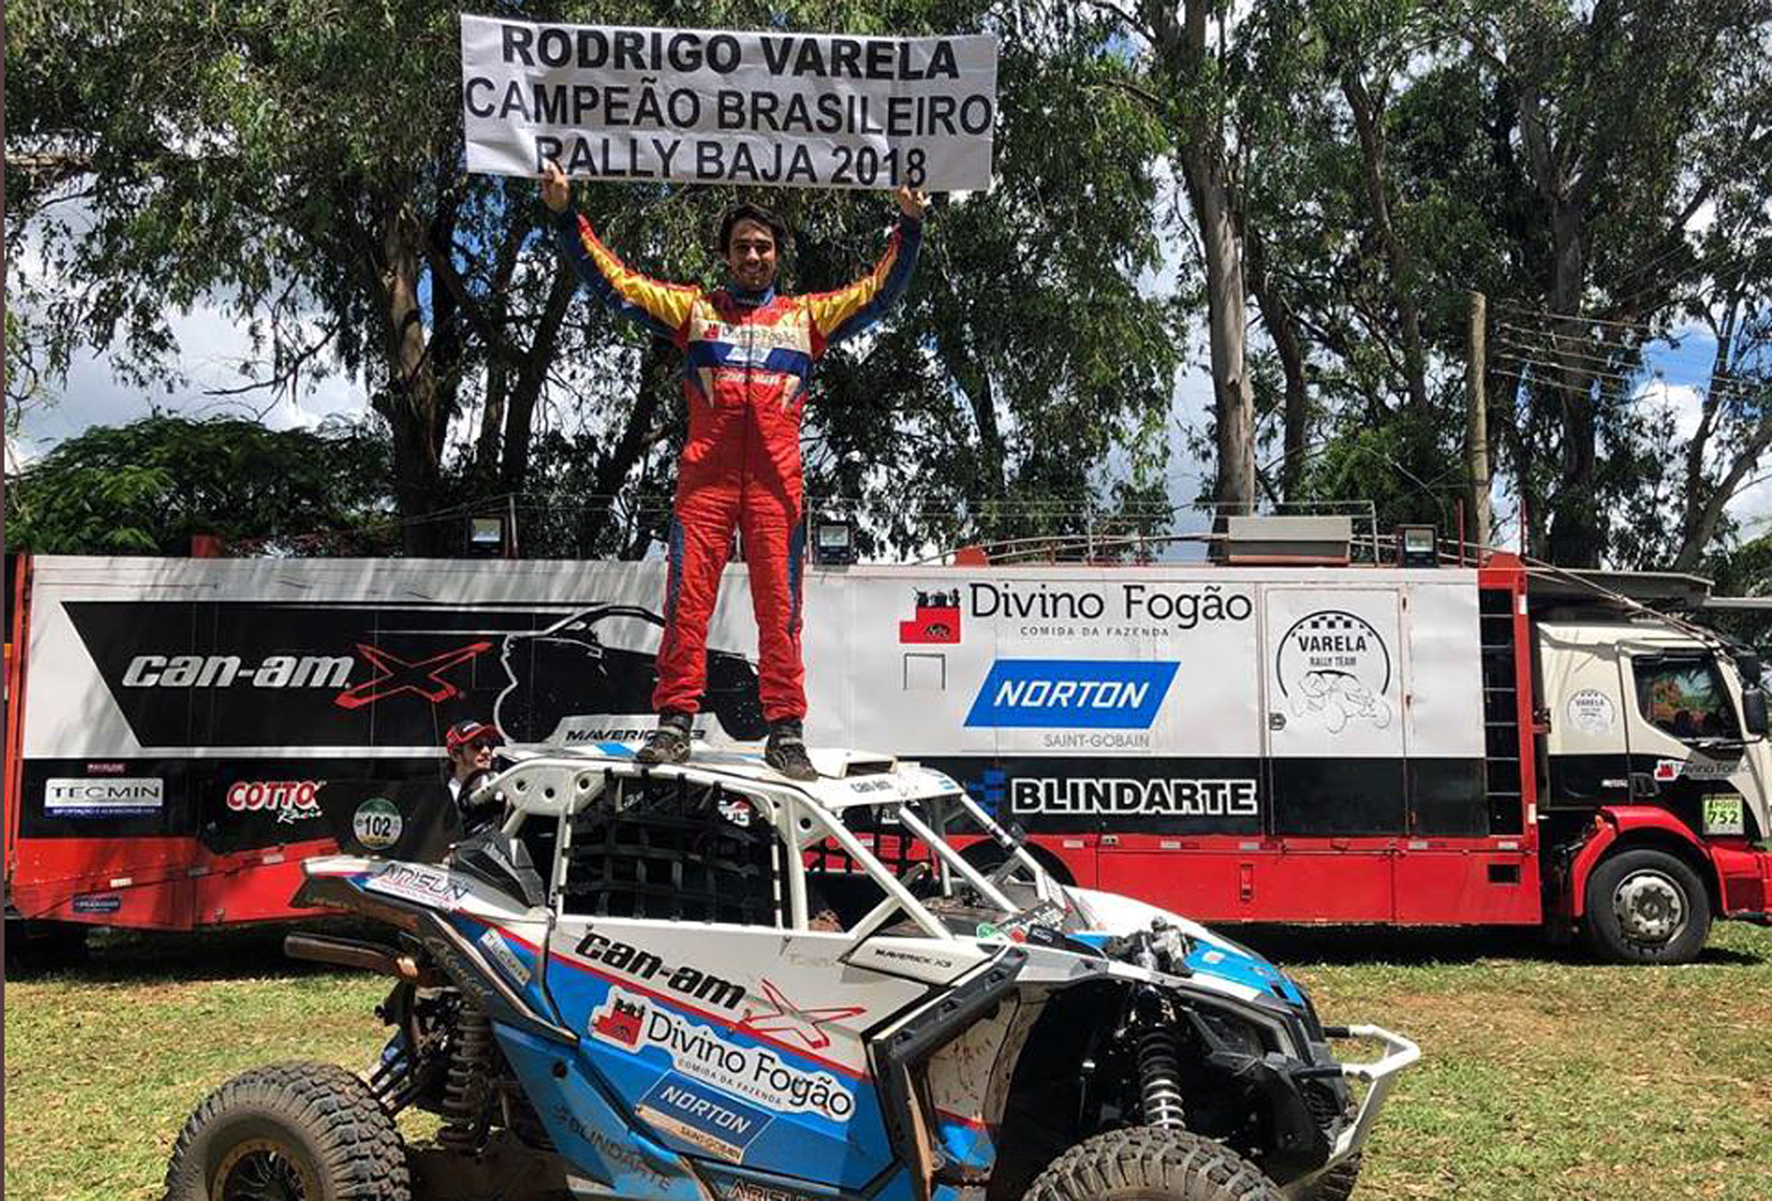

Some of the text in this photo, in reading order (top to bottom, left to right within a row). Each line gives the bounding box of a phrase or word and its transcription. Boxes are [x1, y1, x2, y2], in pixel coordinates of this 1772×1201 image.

[501, 24, 959, 80] RODRIGO VARELA
[465, 76, 992, 137] CAMPEÃO BRASILEIRO
[535, 136, 926, 188] RALLY BAJA 2018
[969, 582, 1253, 630] Divino Fogão
[1020, 626, 1170, 638] COMIDA DA FAZENDA
[1297, 635, 1367, 652] VARELA
[122, 655, 355, 690] can-am
[1308, 657, 1356, 667] RALLY TEAM
[993, 680, 1150, 708] NORTON
[565, 730, 657, 741] MAVERIC
[1043, 733, 1150, 749] SAINT-GOBAIN
[50, 786, 159, 799] TECMIN
[226, 781, 327, 811] COTTO
[1012, 778, 1258, 816] BLINDARTE
[365, 816, 392, 837] 102
[1708, 811, 1738, 825] 752
[874, 948, 931, 965] MAVERICK
[575, 933, 747, 1010] can-am
[649, 1011, 851, 1116] Divino Fogão
[660, 1085, 751, 1134] NORTON
